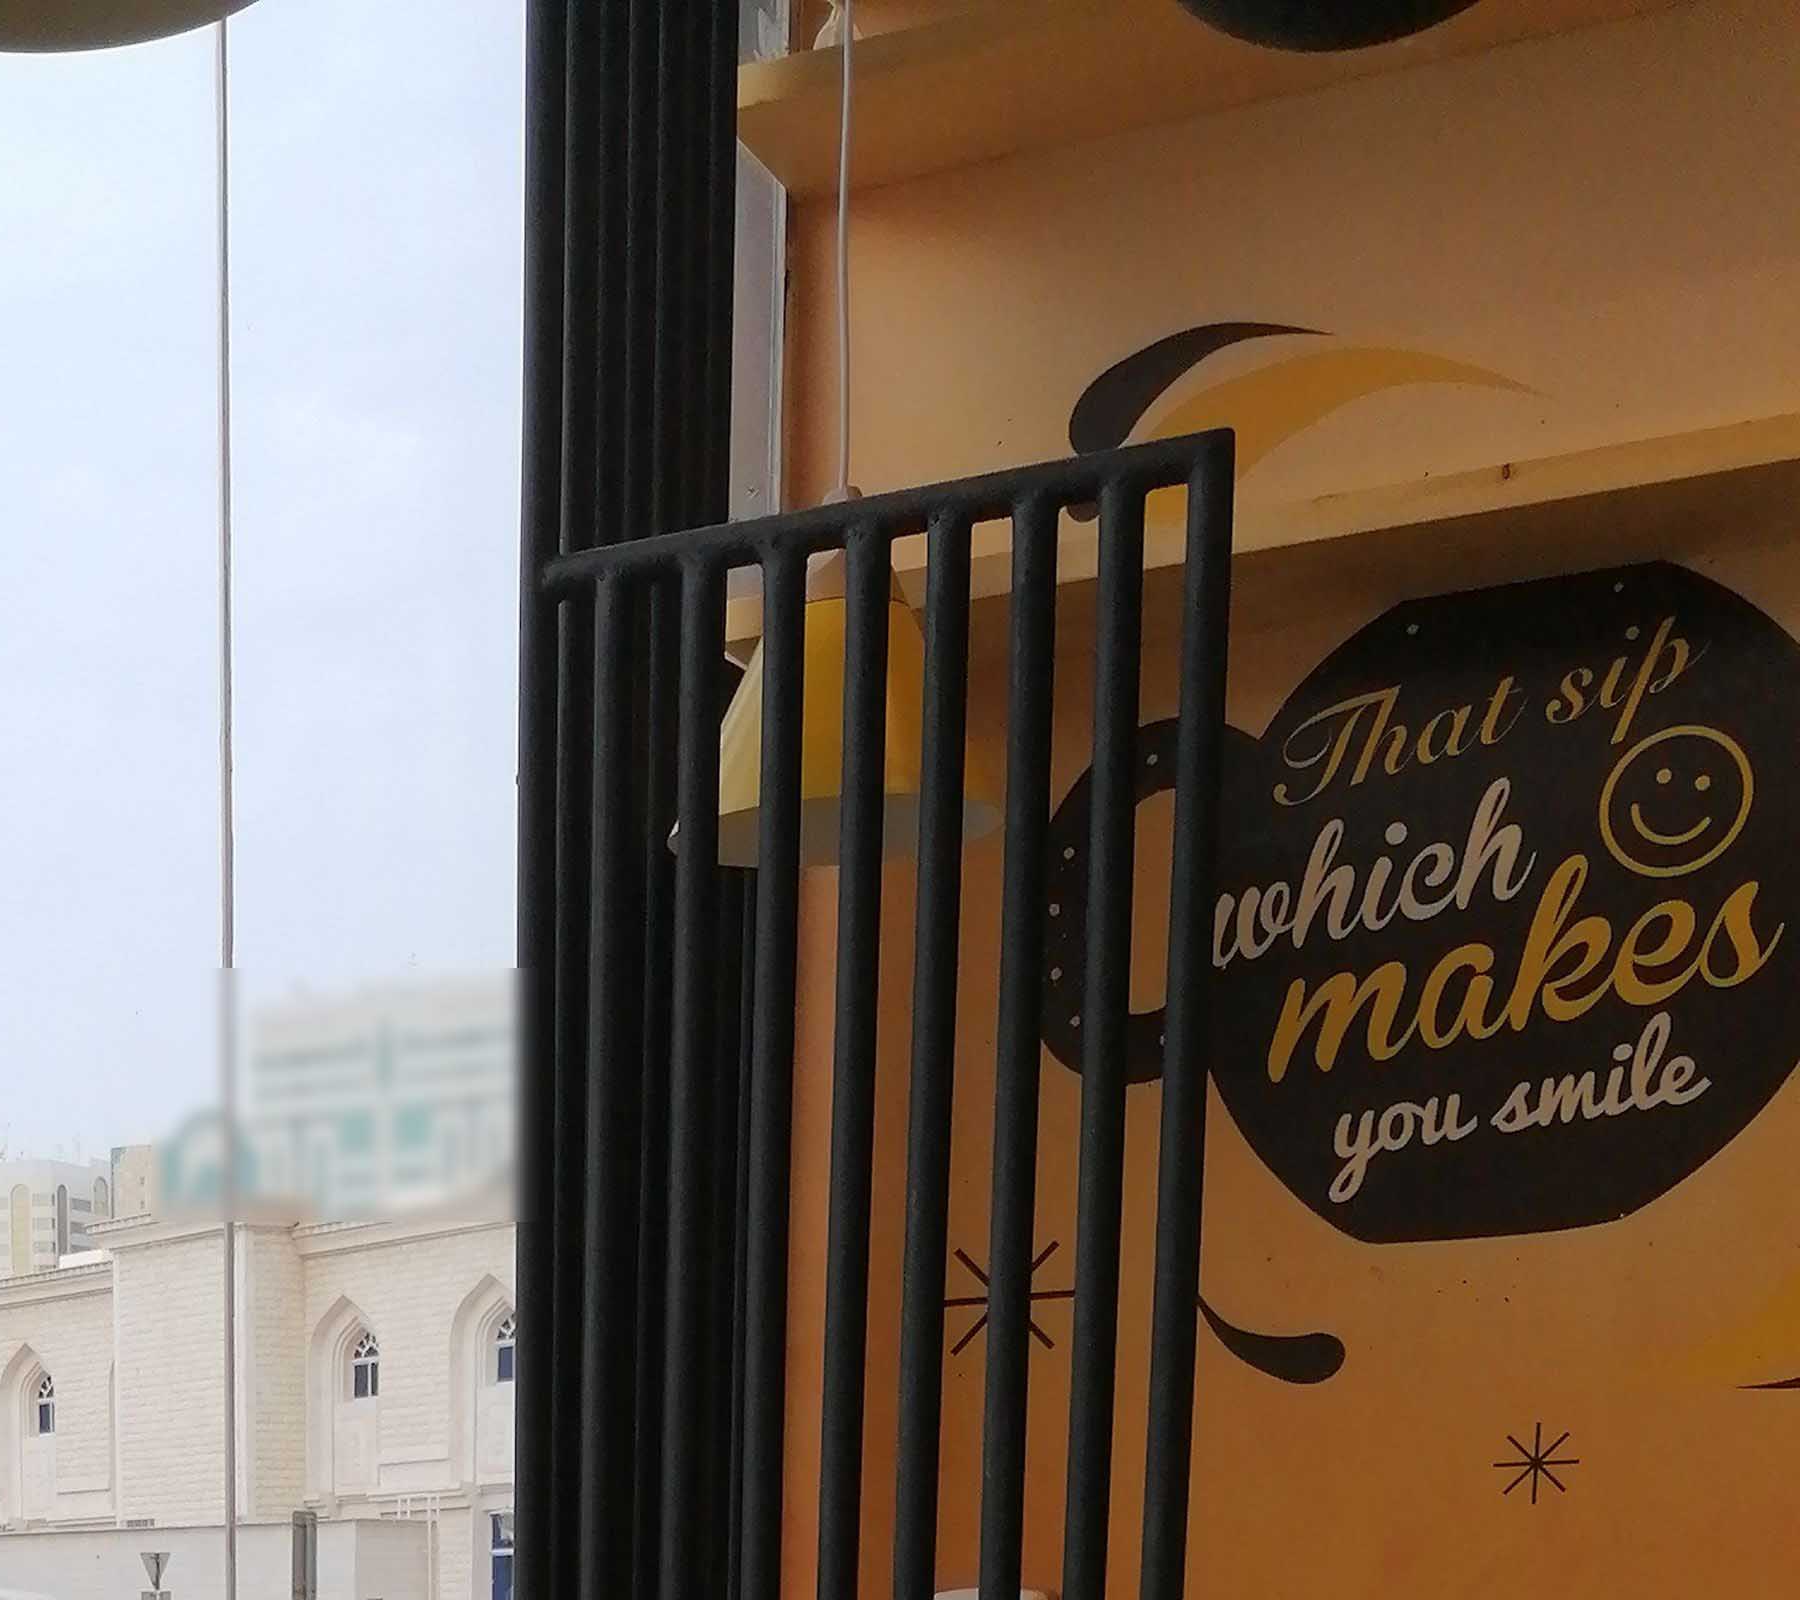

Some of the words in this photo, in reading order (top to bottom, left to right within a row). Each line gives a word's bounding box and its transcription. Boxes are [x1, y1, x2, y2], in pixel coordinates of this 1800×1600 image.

[1272, 676, 1527, 806] That
[1545, 616, 1709, 744] sip
[1211, 777, 1536, 968] which
[1267, 854, 1784, 1082] makes
[1328, 1092, 1478, 1203] you
[1490, 1011, 1711, 1132] smile
